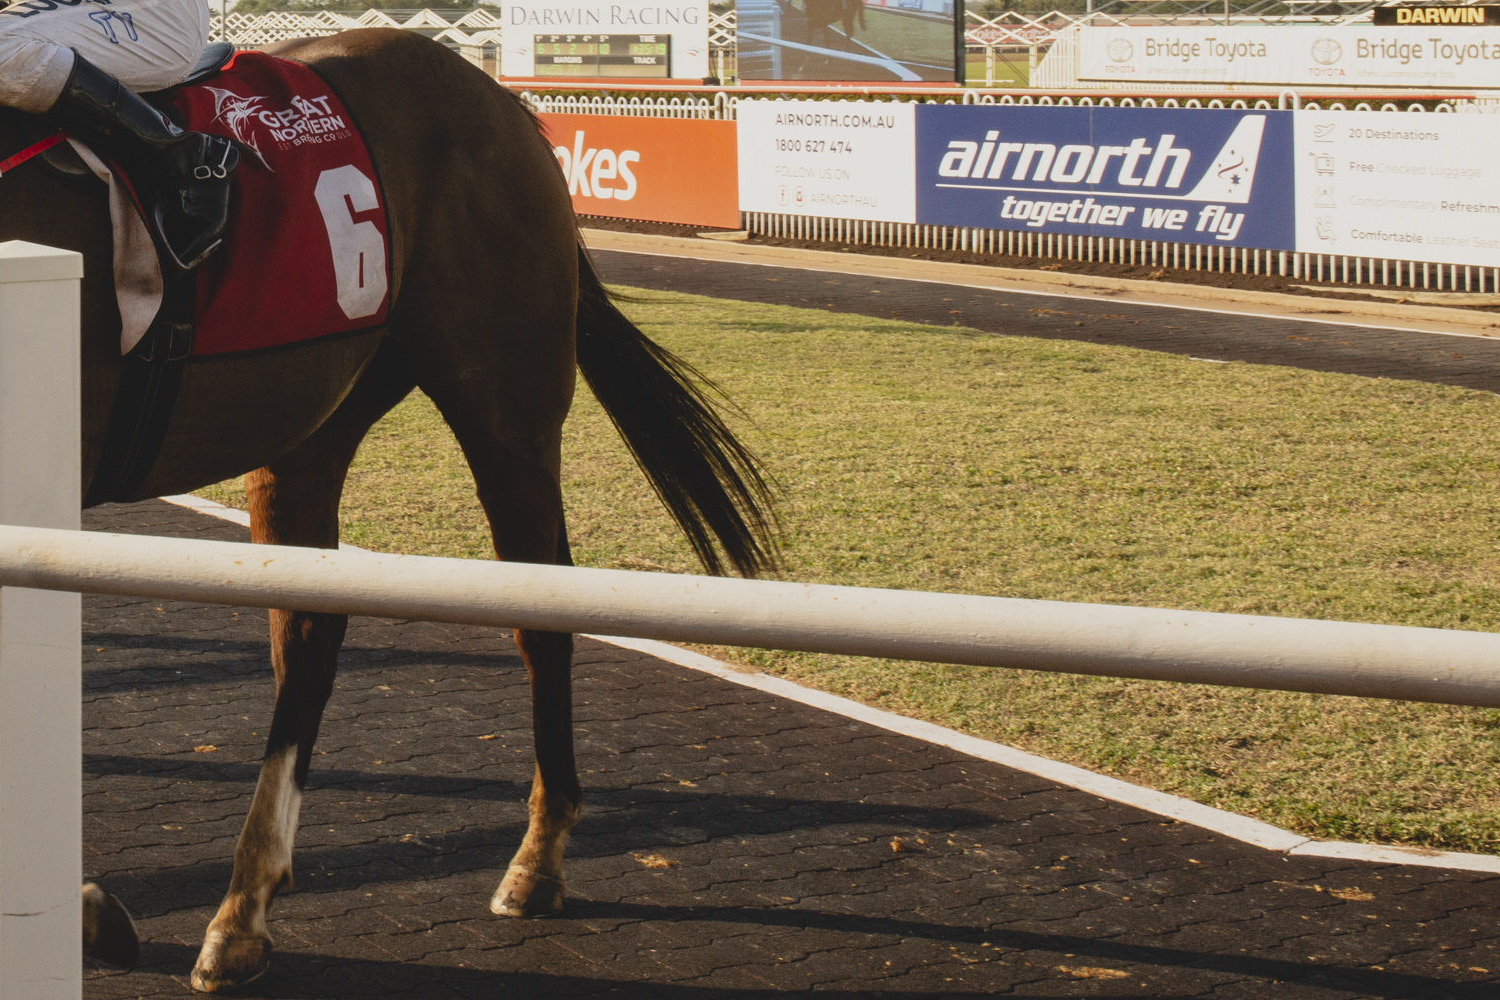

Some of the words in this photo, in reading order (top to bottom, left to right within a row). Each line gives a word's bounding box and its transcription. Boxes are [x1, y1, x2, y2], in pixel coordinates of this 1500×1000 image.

[510, 6, 600, 26] DARWIN
[610, 5, 699, 25] RACING
[1396, 7, 1485, 24] DARWIN
[1145, 37, 1200, 62] Bridge
[1205, 37, 1267, 62] Toyota
[1357, 37, 1423, 65] Bridge
[1428, 37, 1500, 65] Toyota
[1104, 65, 1136, 74] TOYOTA
[1308, 67, 1346, 77] TOYOTA
[775, 113, 895, 129] AIRNORTH.COM.AU
[1348, 128, 1363, 139] 20
[1365, 128, 1440, 141] Destinations
[775, 139, 801, 152] 1800
[805, 140, 826, 152] 627
[830, 141, 852, 154] 474
[938, 130, 1191, 188] airnorth
[775, 165, 816, 178] FOLLOW
[819, 167, 832, 180] US
[835, 168, 851, 180] ON
[1349, 161, 1374, 172] Free
[1377, 162, 1426, 175] Checked
[1429, 164, 1482, 180] Luggage
[810, 193, 877, 208] AIRNORTHAU
[1350, 195, 1437, 213] Complimentary
[1440, 200, 1500, 214] Refreshm
[1000, 196, 1135, 227] together
[1141, 207, 1188, 231] we
[1195, 205, 1245, 241] fly
[314, 164, 388, 320] 6
[1350, 228, 1424, 244] Comfortable
[1427, 233, 1470, 246] Leather
